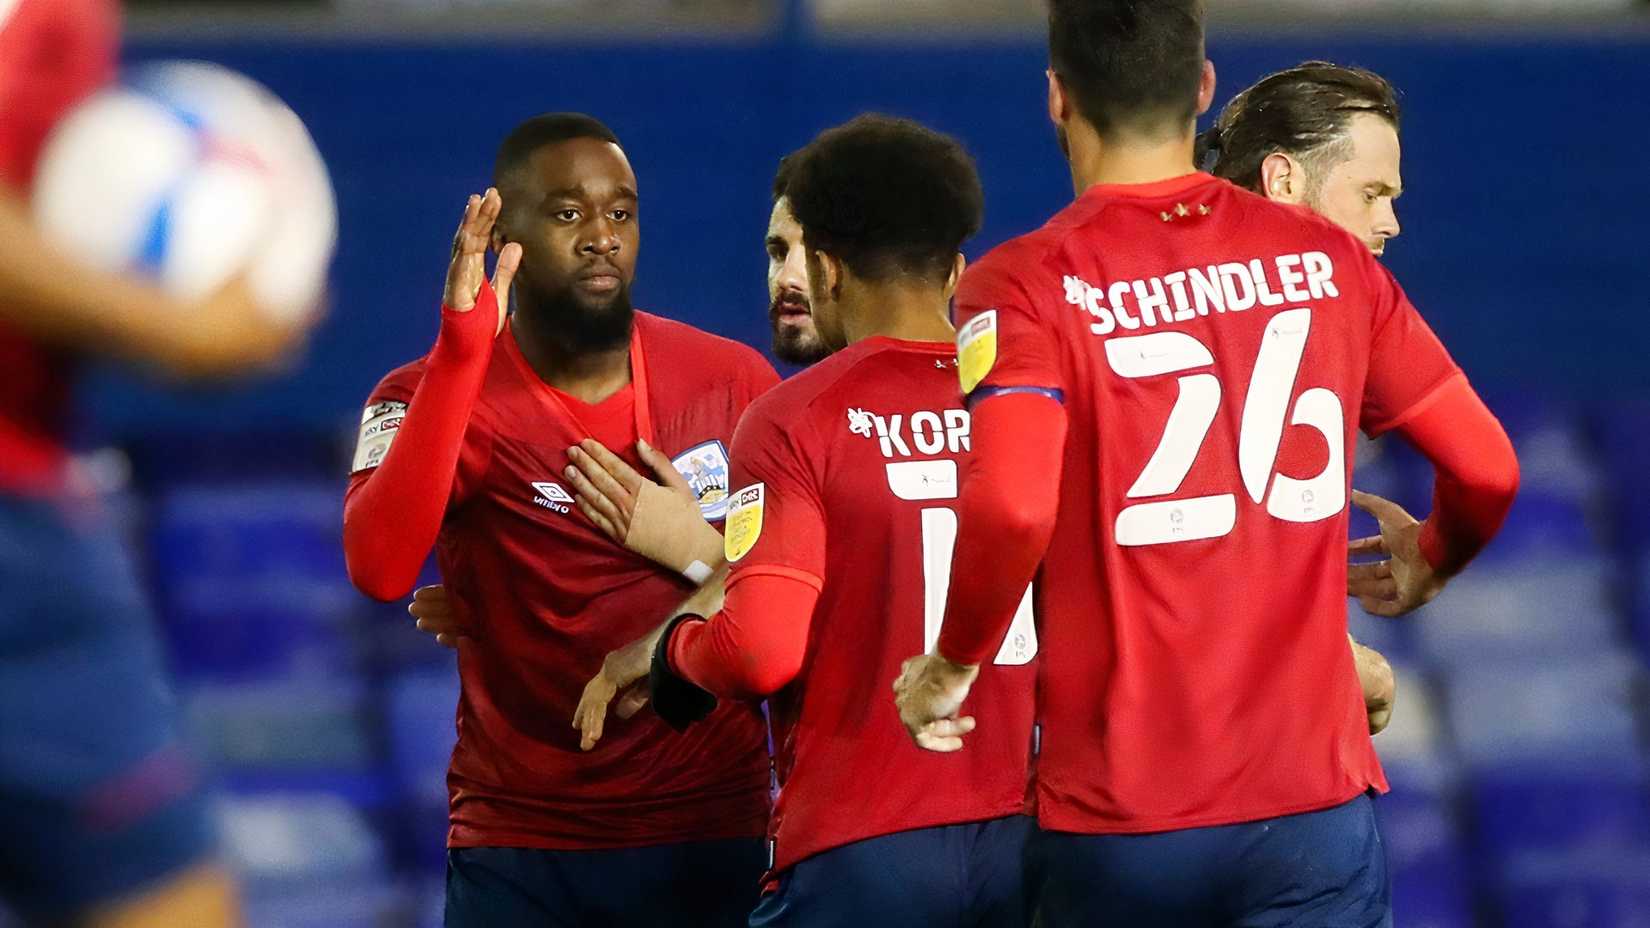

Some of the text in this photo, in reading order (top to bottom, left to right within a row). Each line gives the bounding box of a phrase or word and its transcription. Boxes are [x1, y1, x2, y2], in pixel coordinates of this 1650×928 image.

[1089, 250, 1340, 335] SCHINDLER
[1103, 307, 1347, 547] 26
[533, 495, 570, 514] umbro
